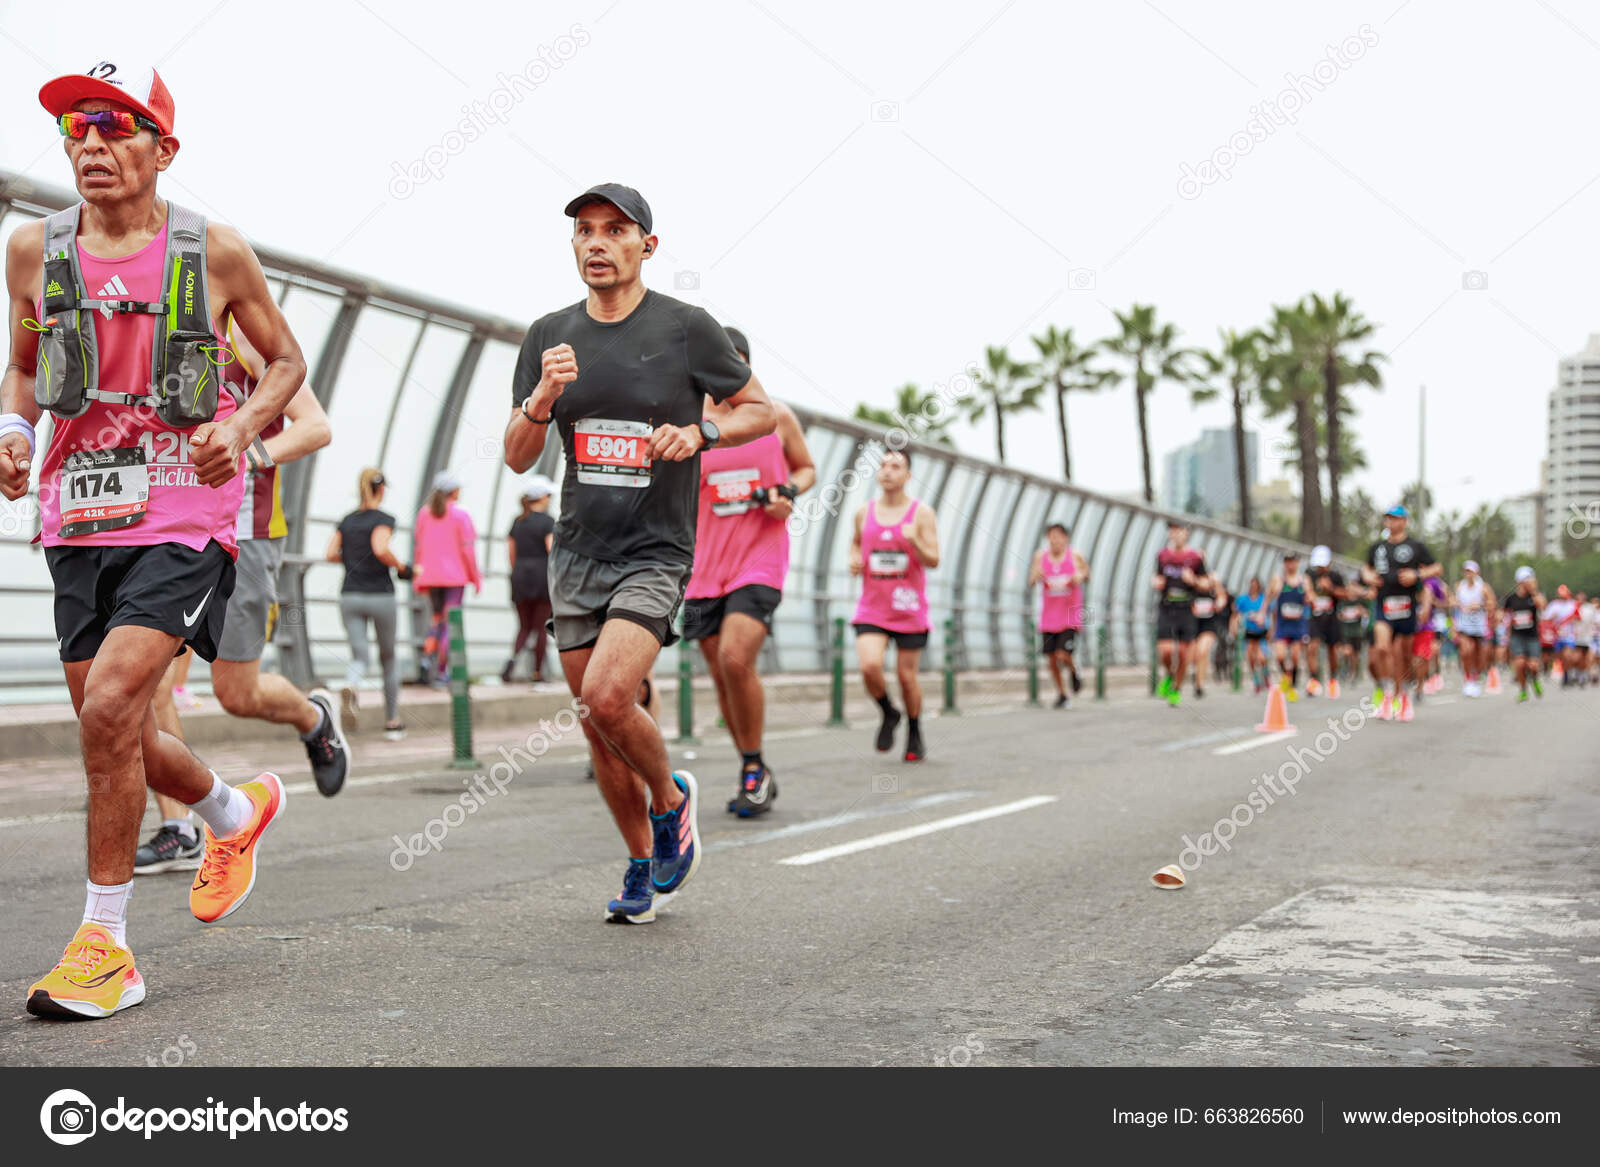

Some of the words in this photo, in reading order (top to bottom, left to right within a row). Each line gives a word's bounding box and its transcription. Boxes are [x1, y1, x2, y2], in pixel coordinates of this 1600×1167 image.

[586, 436, 637, 459] 5901
[148, 467, 203, 487] diclu
[83, 508, 106, 518] 42K
